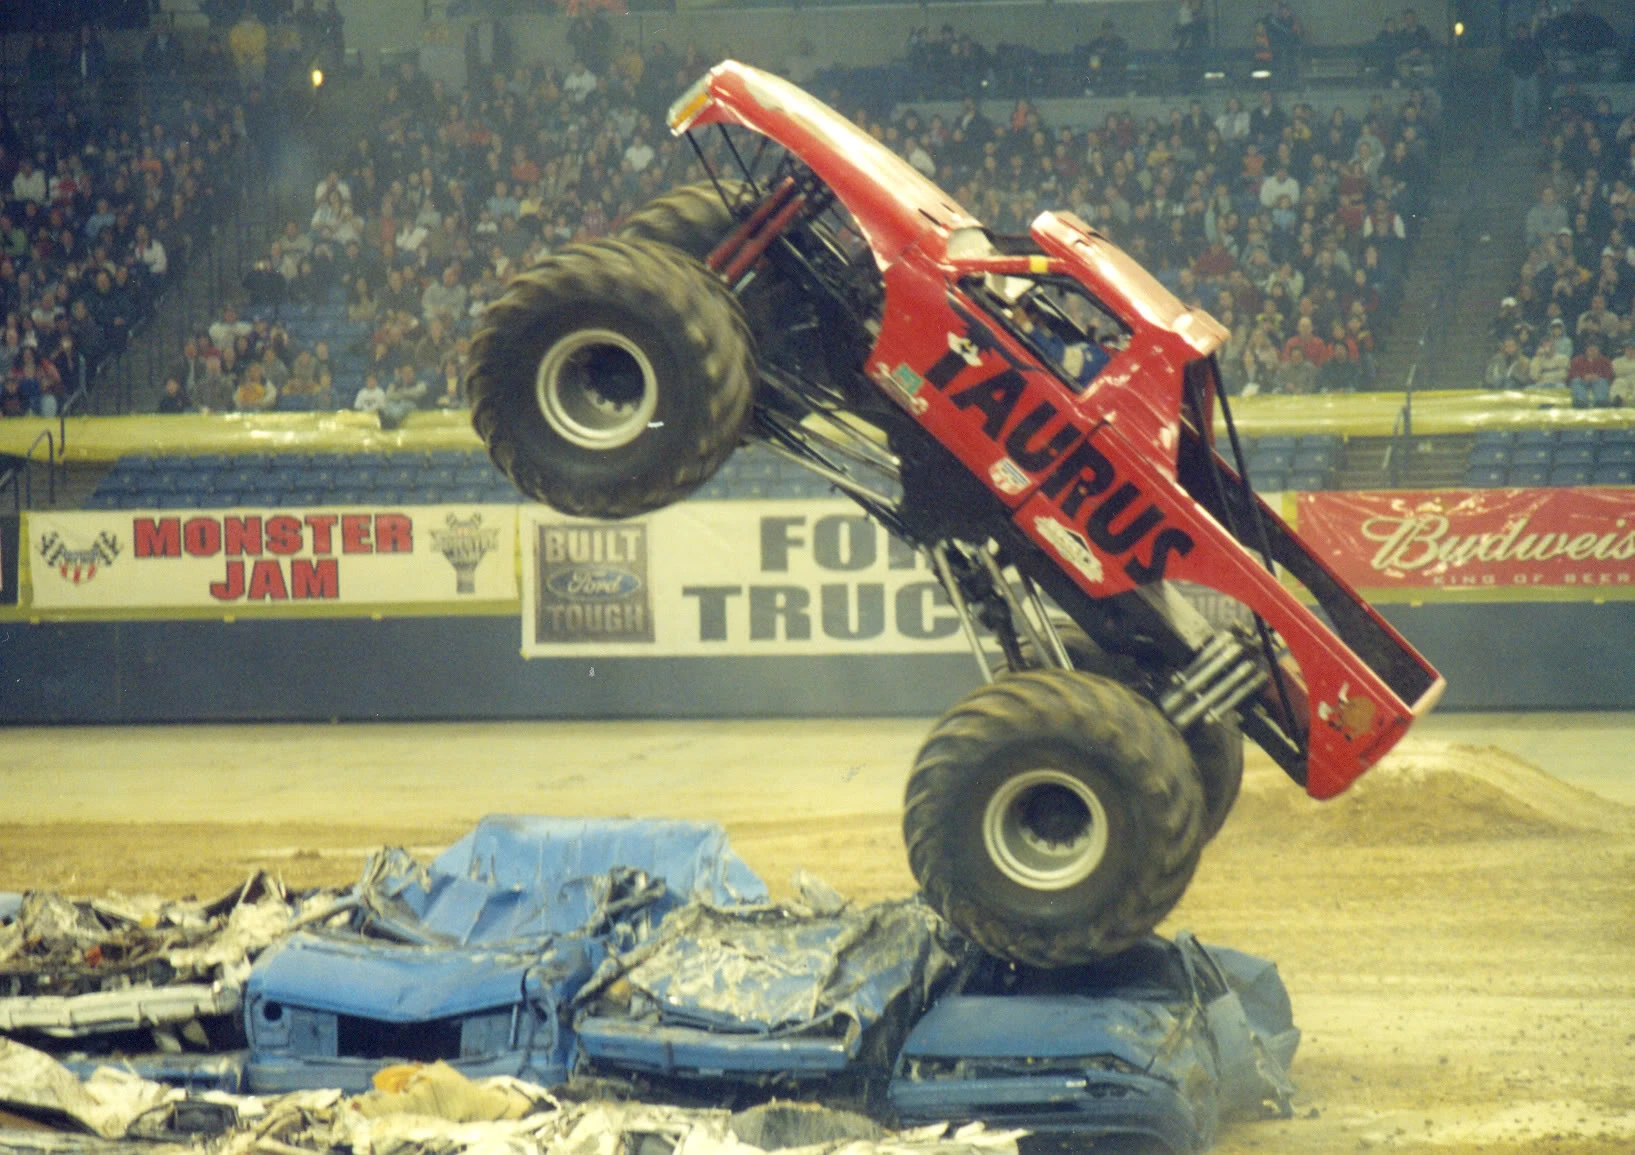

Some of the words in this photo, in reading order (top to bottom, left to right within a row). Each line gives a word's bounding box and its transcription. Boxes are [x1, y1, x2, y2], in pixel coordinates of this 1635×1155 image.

[133, 514, 413, 558] MONSTER
[544, 529, 641, 563] BUILT
[760, 515, 945, 573] FO
[209, 559, 340, 600] JAM
[567, 571, 624, 594] Ford
[1433, 574, 1495, 585] KING
[1513, 573, 1543, 584] OF
[544, 603, 645, 633] TOUGH
